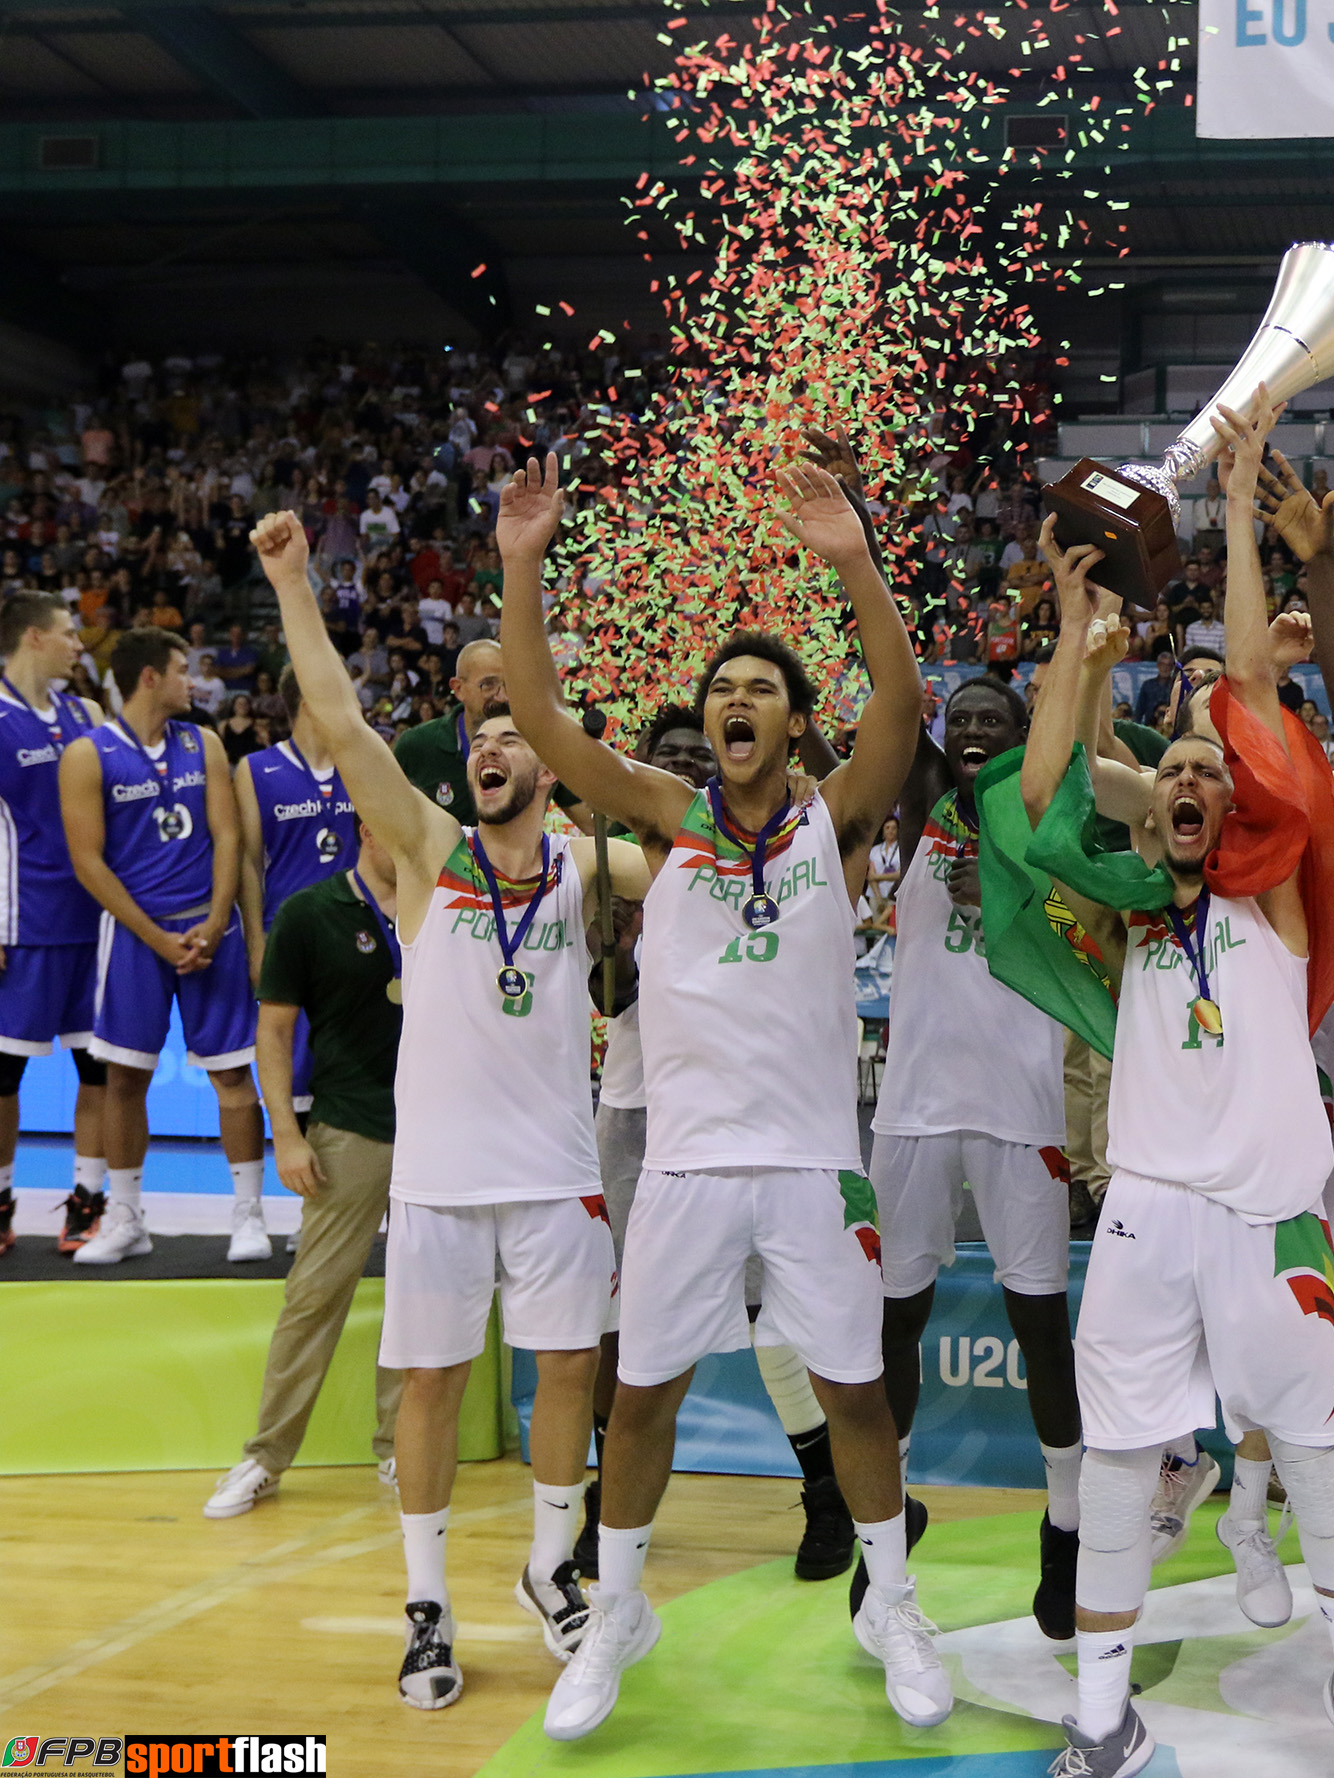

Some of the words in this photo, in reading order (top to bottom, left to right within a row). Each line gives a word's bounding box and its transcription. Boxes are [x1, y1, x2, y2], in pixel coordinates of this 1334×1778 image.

[1235, 0, 1307, 47] EU
[112, 778, 160, 803] Czech
[274, 799, 317, 821] Czech
[688, 857, 828, 912] PORGAL
[718, 931, 780, 964] 15
[1107, 1227, 1136, 1240] DHIKA
